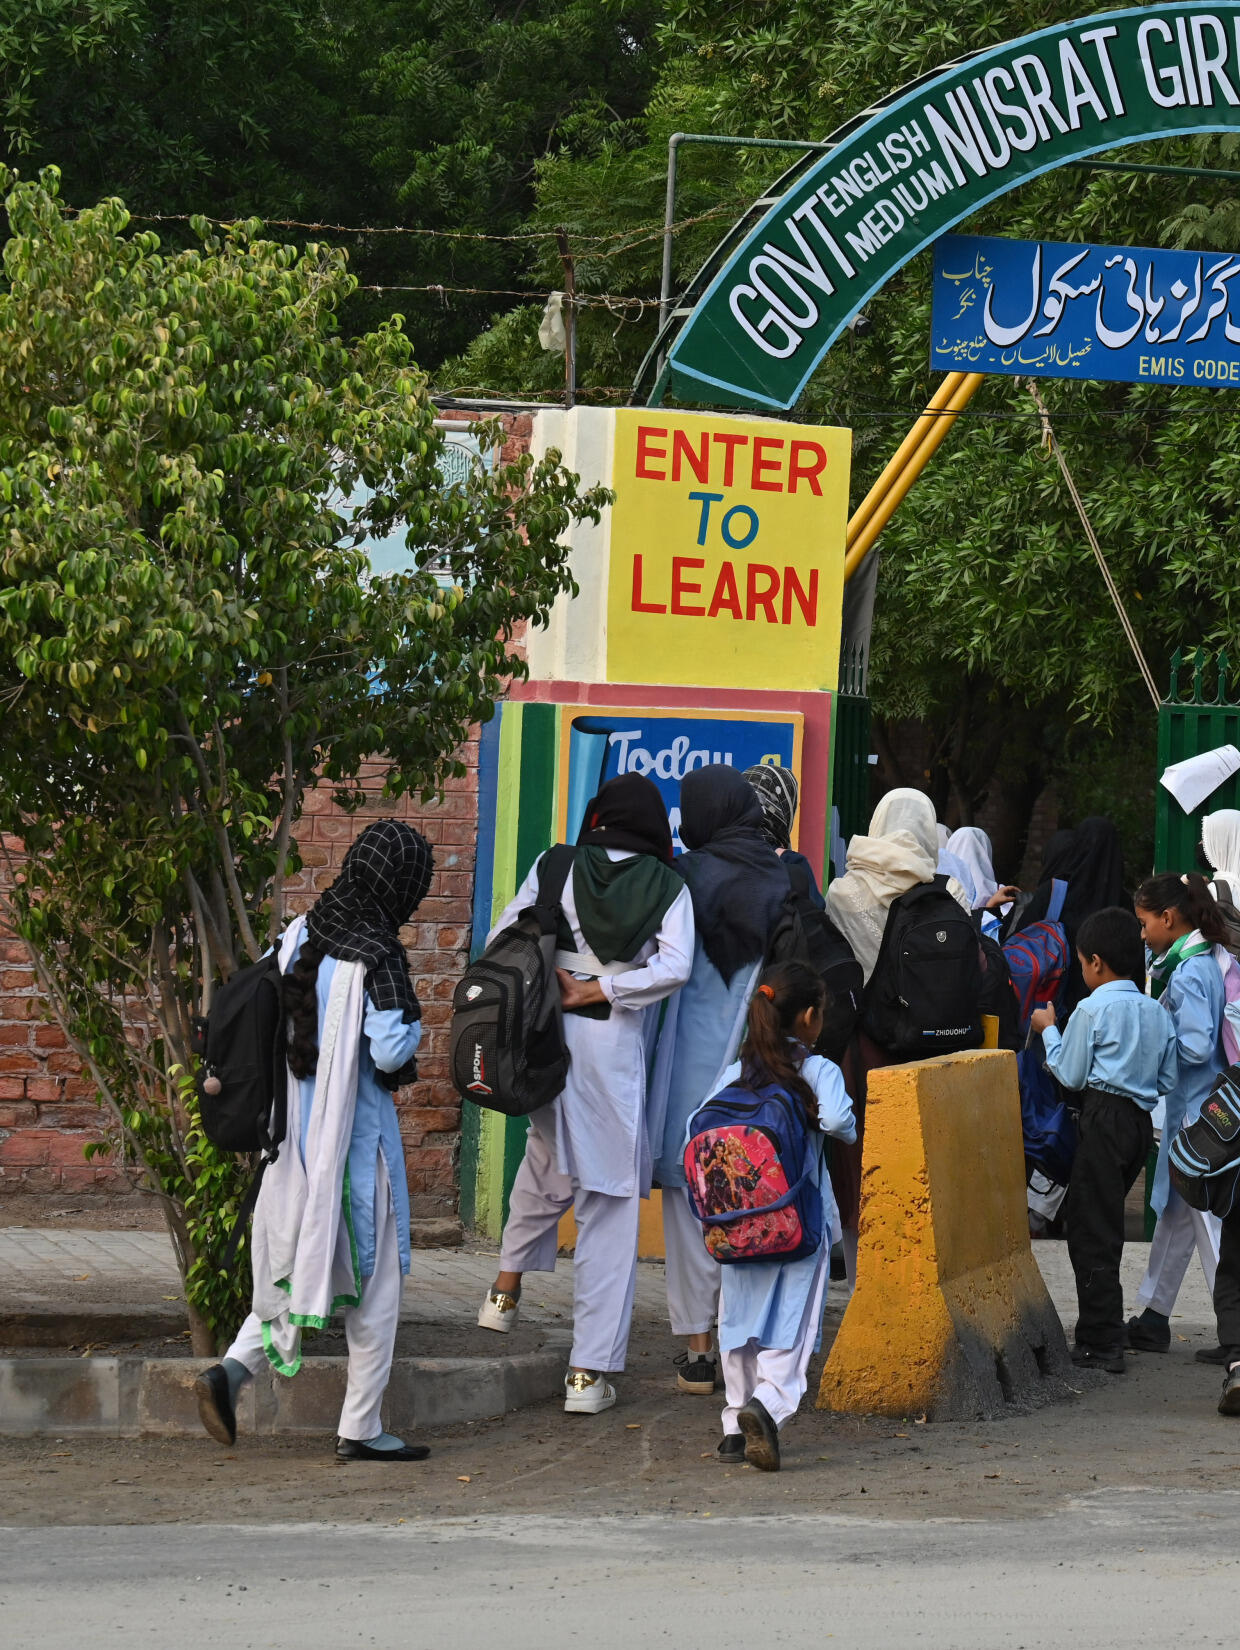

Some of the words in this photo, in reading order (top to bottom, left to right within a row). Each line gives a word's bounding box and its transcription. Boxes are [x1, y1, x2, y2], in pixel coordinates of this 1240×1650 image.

[729, 195, 855, 359] GOVT
[816, 120, 932, 218] ENGLISH
[923, 26, 1124, 186] NUSRAT
[845, 160, 955, 262] MEDIUM
[942, 250, 994, 288] چناب
[952, 288, 977, 320] نگر
[984, 244, 1102, 347] سکول
[1096, 255, 1165, 348] ہائی
[935, 337, 969, 361] چنیوٹ
[968, 336, 987, 361] ضلع
[1056, 337, 1093, 367] تحصیل
[1139, 355, 1185, 377] EMIS
[1193, 359, 1240, 381] CODE
[635, 425, 828, 497] ENTER
[688, 491, 760, 549] TO
[631, 553, 819, 627] LEARN
[473, 1043, 482, 1080] SPORT
